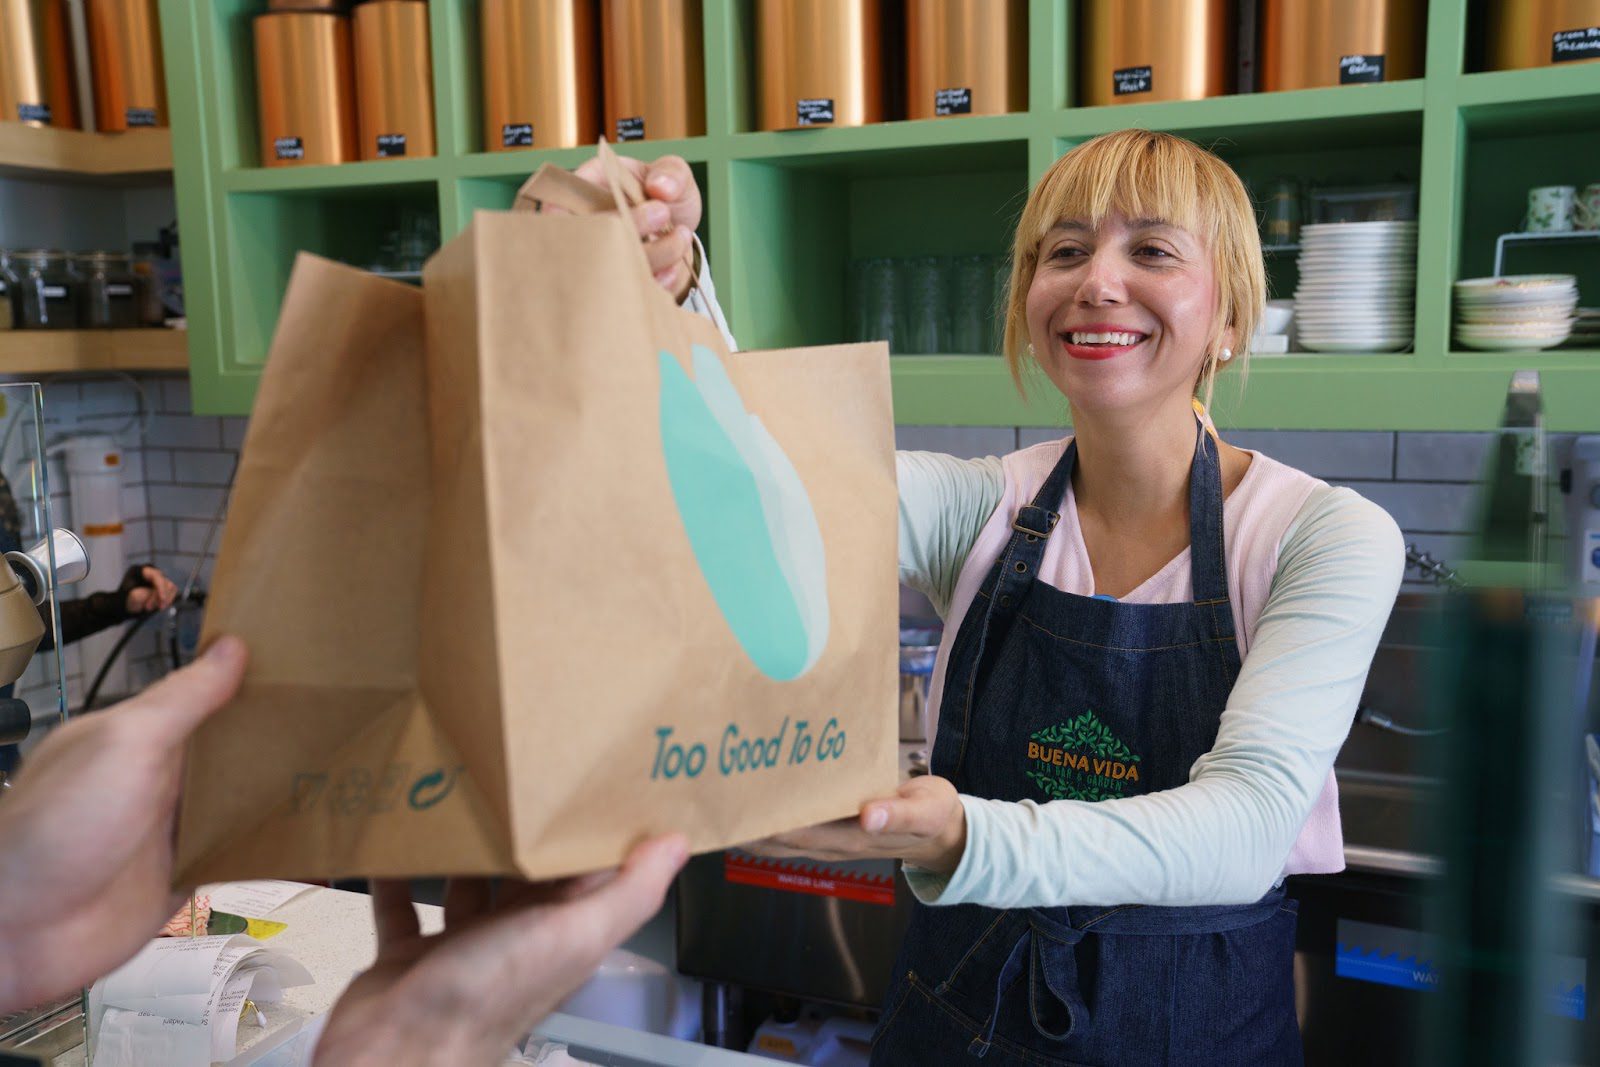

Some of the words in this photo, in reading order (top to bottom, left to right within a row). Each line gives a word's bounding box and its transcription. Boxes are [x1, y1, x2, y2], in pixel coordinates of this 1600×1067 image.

[651, 727, 707, 780] Too
[719, 715, 790, 776] Good
[788, 720, 812, 765] To
[816, 717, 846, 761] Go
[1027, 741, 1089, 772] BUENA
[1092, 757, 1139, 781] VIDA
[1086, 775, 1121, 791] GARDEN
[777, 873, 811, 887] WATER
[812, 877, 835, 890] LINE
